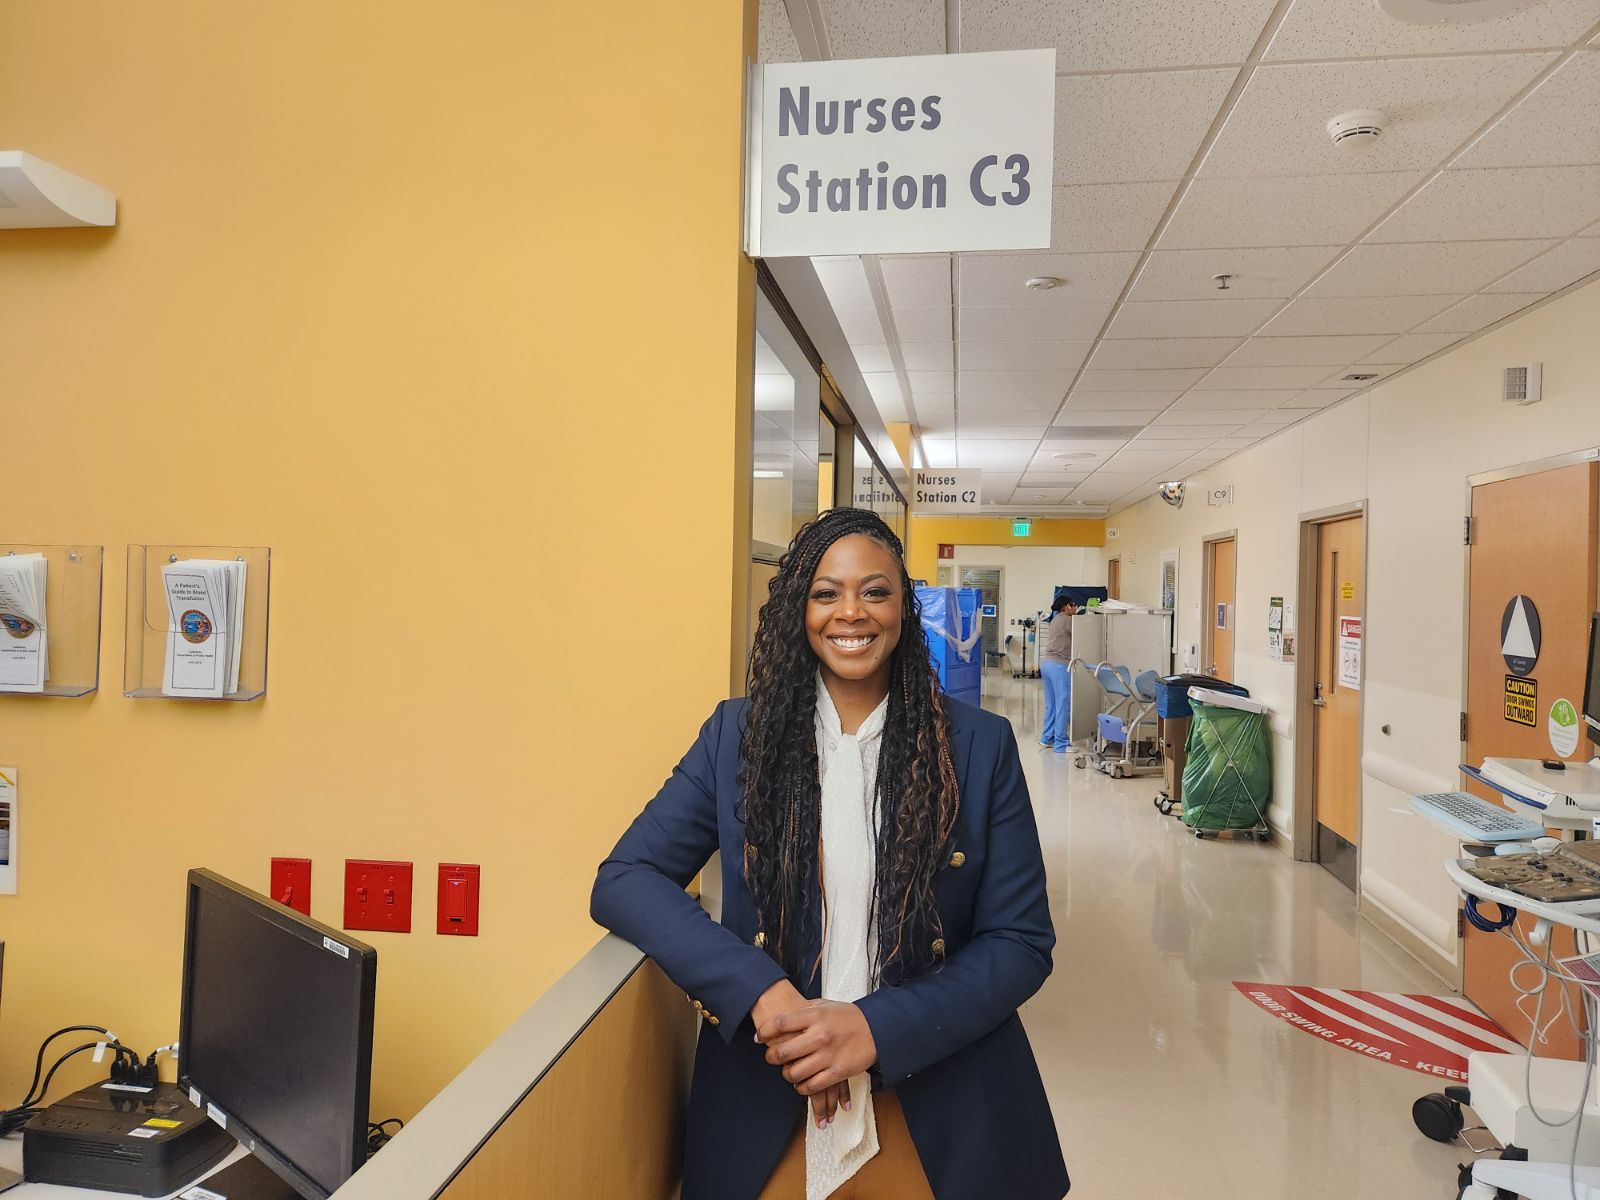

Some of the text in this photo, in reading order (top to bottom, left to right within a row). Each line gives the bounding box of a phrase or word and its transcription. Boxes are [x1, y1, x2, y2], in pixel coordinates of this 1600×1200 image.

[778, 86, 942, 137] Nurses
[776, 153, 1031, 214] Station C3
[917, 473, 956, 485] Nurses
[916, 491, 976, 503] Station C2
[1214, 490, 1227, 499] C9
[1506, 680, 1535, 696] CAUTION
[1506, 694, 1535, 709] DOOR SWINGS
[1506, 704, 1534, 722] OUTWARD
[1248, 991, 1287, 1011] DOOR
[1280, 1011, 1338, 1038] SWING
[1336, 1037, 1392, 1060] AREA
